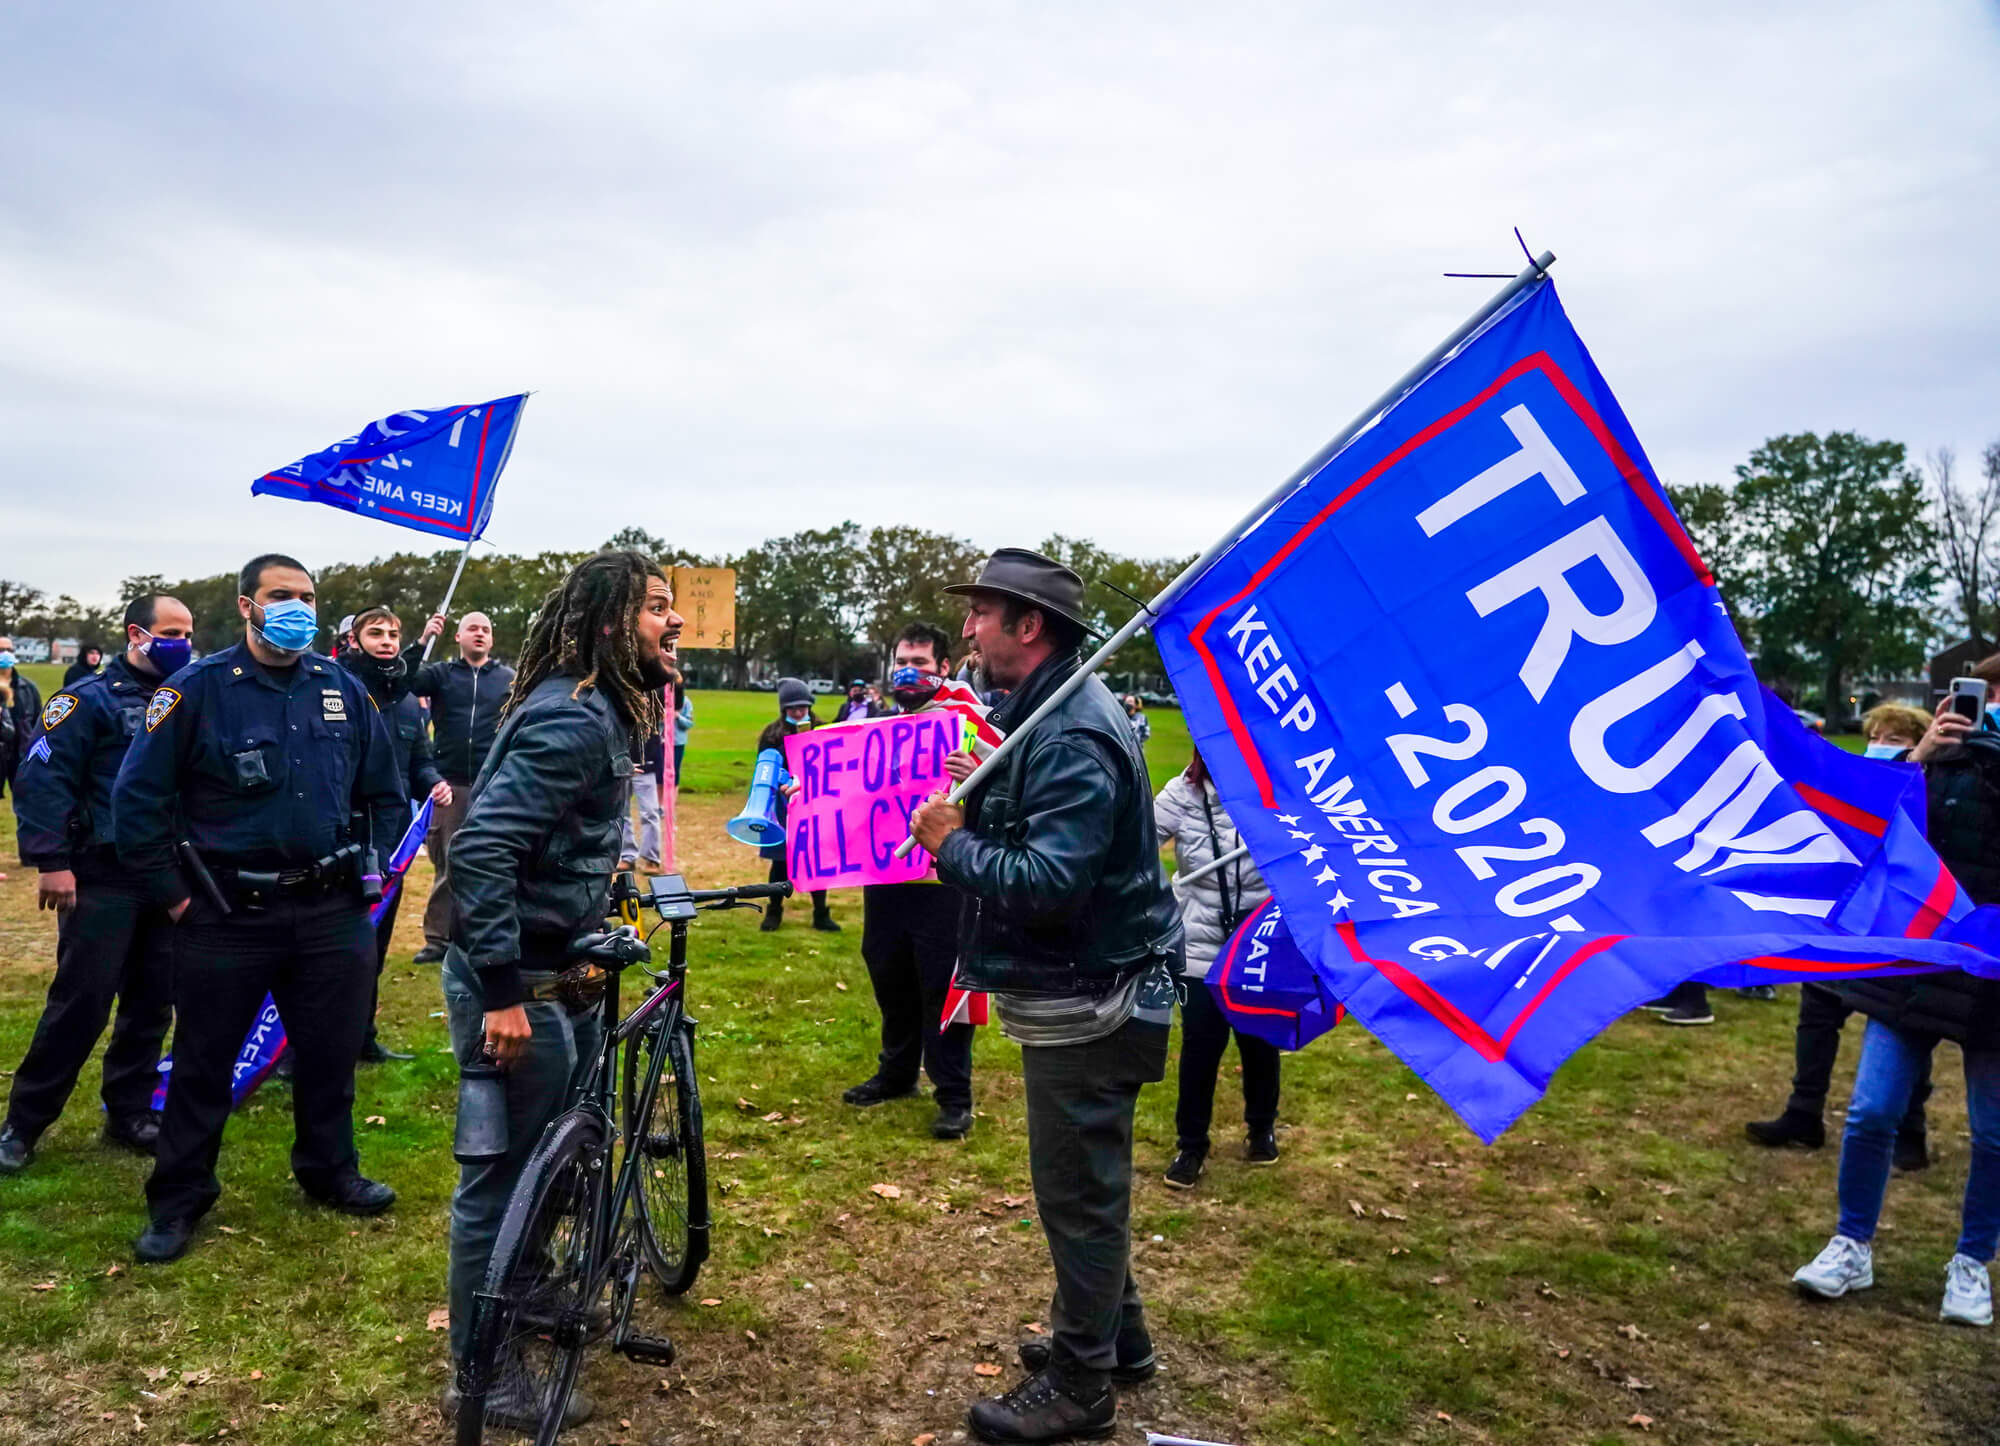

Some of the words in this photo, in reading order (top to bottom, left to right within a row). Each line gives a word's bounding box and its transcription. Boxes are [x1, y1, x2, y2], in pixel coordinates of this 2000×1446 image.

[690, 575, 712, 585] LAW
[1415, 403, 1863, 919] TRUM
[802, 716, 958, 804] RE-OPEN
[1227, 604, 1317, 732] KEEP
[1295, 747, 1440, 919] AMERICA
[791, 809, 861, 880] ALL
[870, 793, 927, 871] GY
